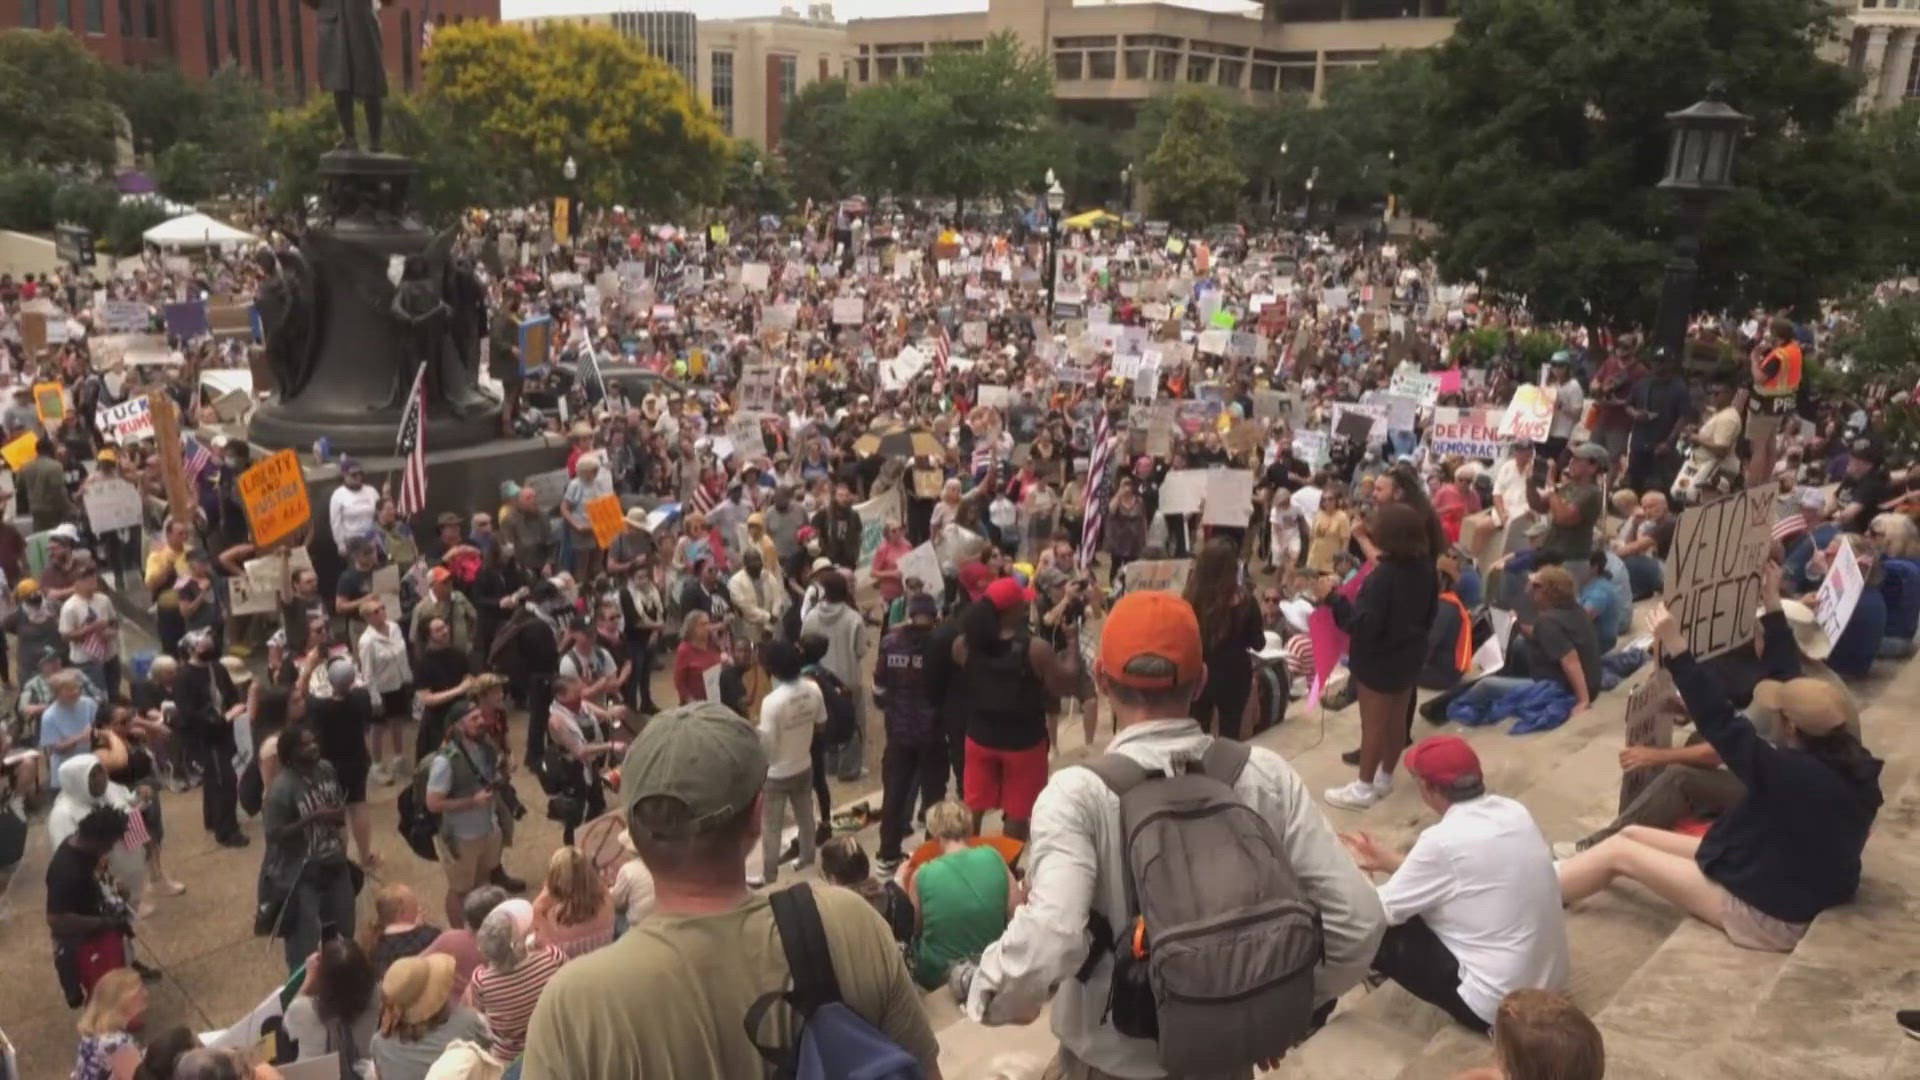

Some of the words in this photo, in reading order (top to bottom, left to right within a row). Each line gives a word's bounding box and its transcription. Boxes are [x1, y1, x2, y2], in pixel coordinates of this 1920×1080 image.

[102, 399, 147, 425] FUCK
[1432, 440, 1501, 457] DEMOCRACY
[1675, 489, 1748, 588] VETO
[1741, 541, 1764, 573] THE
